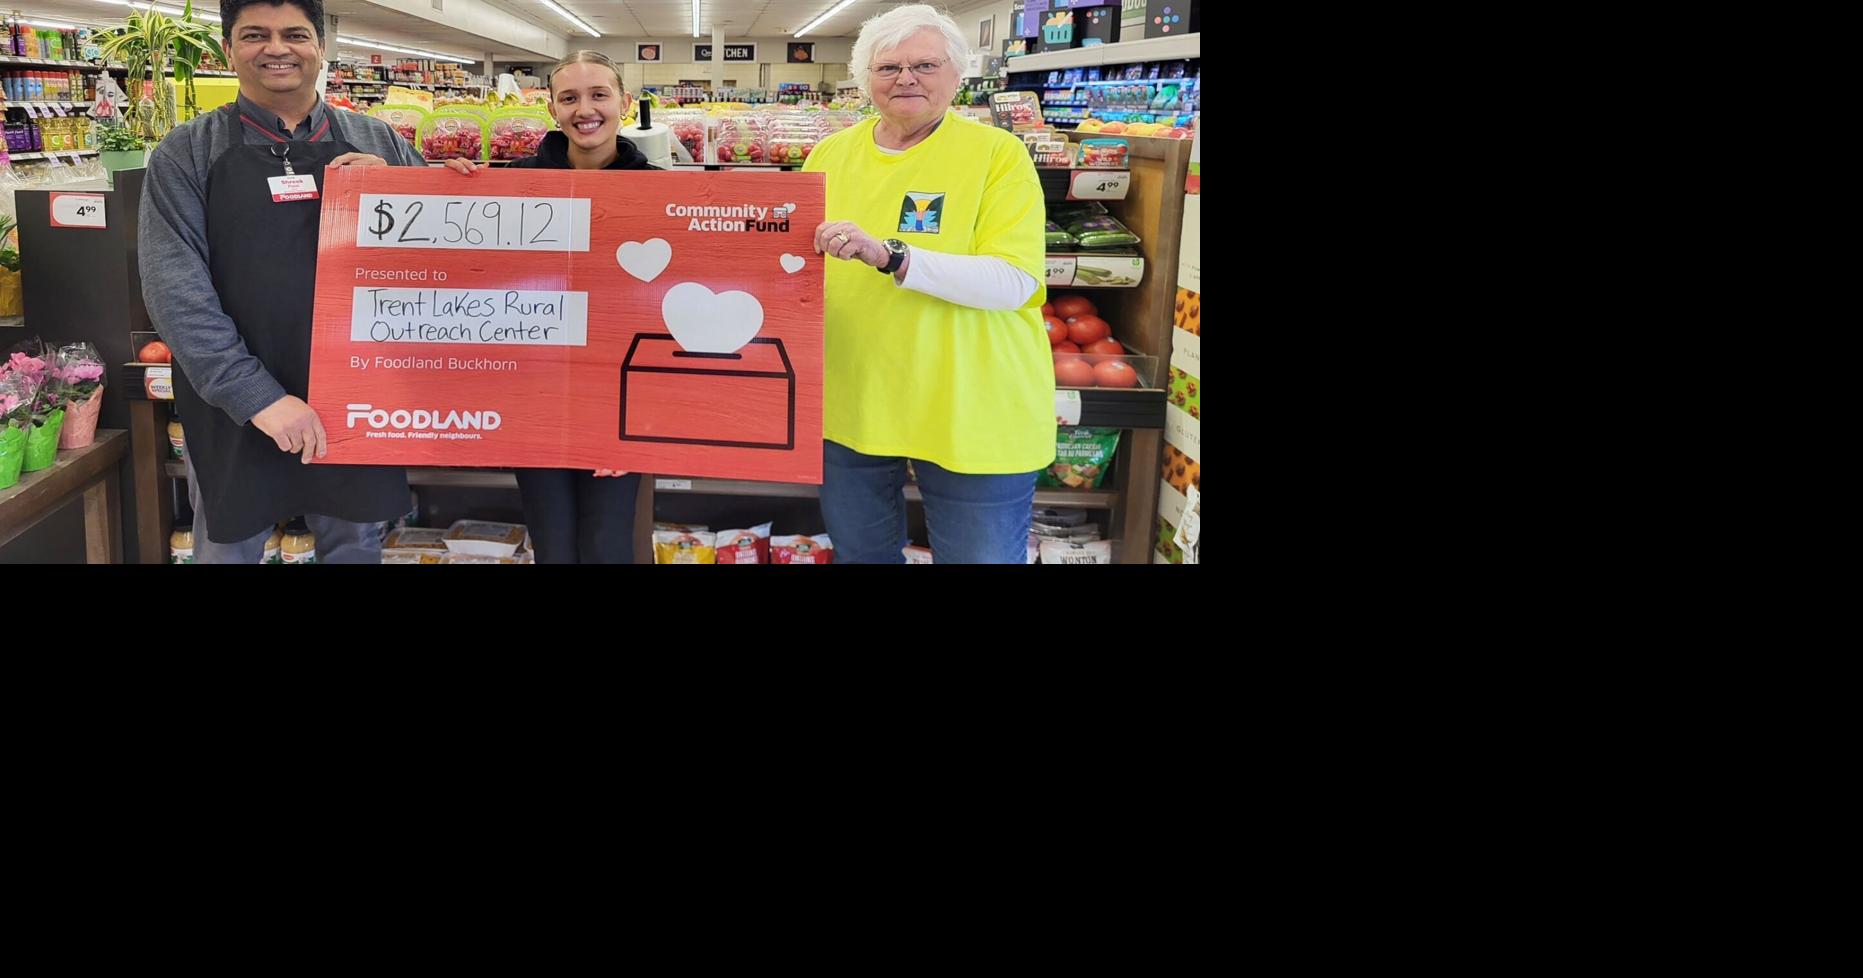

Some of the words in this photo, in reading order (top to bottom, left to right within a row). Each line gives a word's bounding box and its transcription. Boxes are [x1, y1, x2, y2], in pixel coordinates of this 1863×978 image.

[665, 203, 768, 220] Community
[368, 199, 558, 246] $2,569.12
[355, 267, 427, 281] Presented
[433, 269, 448, 281] to
[368, 288, 424, 318] Trent
[504, 291, 564, 321] Rural
[370, 321, 472, 342] Outreach
[479, 320, 559, 341] Center
[350, 356, 370, 370] By
[375, 356, 443, 369] Foodland
[448, 358, 517, 371] Buckhorn
[346, 403, 502, 430] FOODLAND
[366, 431, 387, 439] Fresh
[388, 431, 406, 439] food.
[408, 432, 438, 440] Friendly
